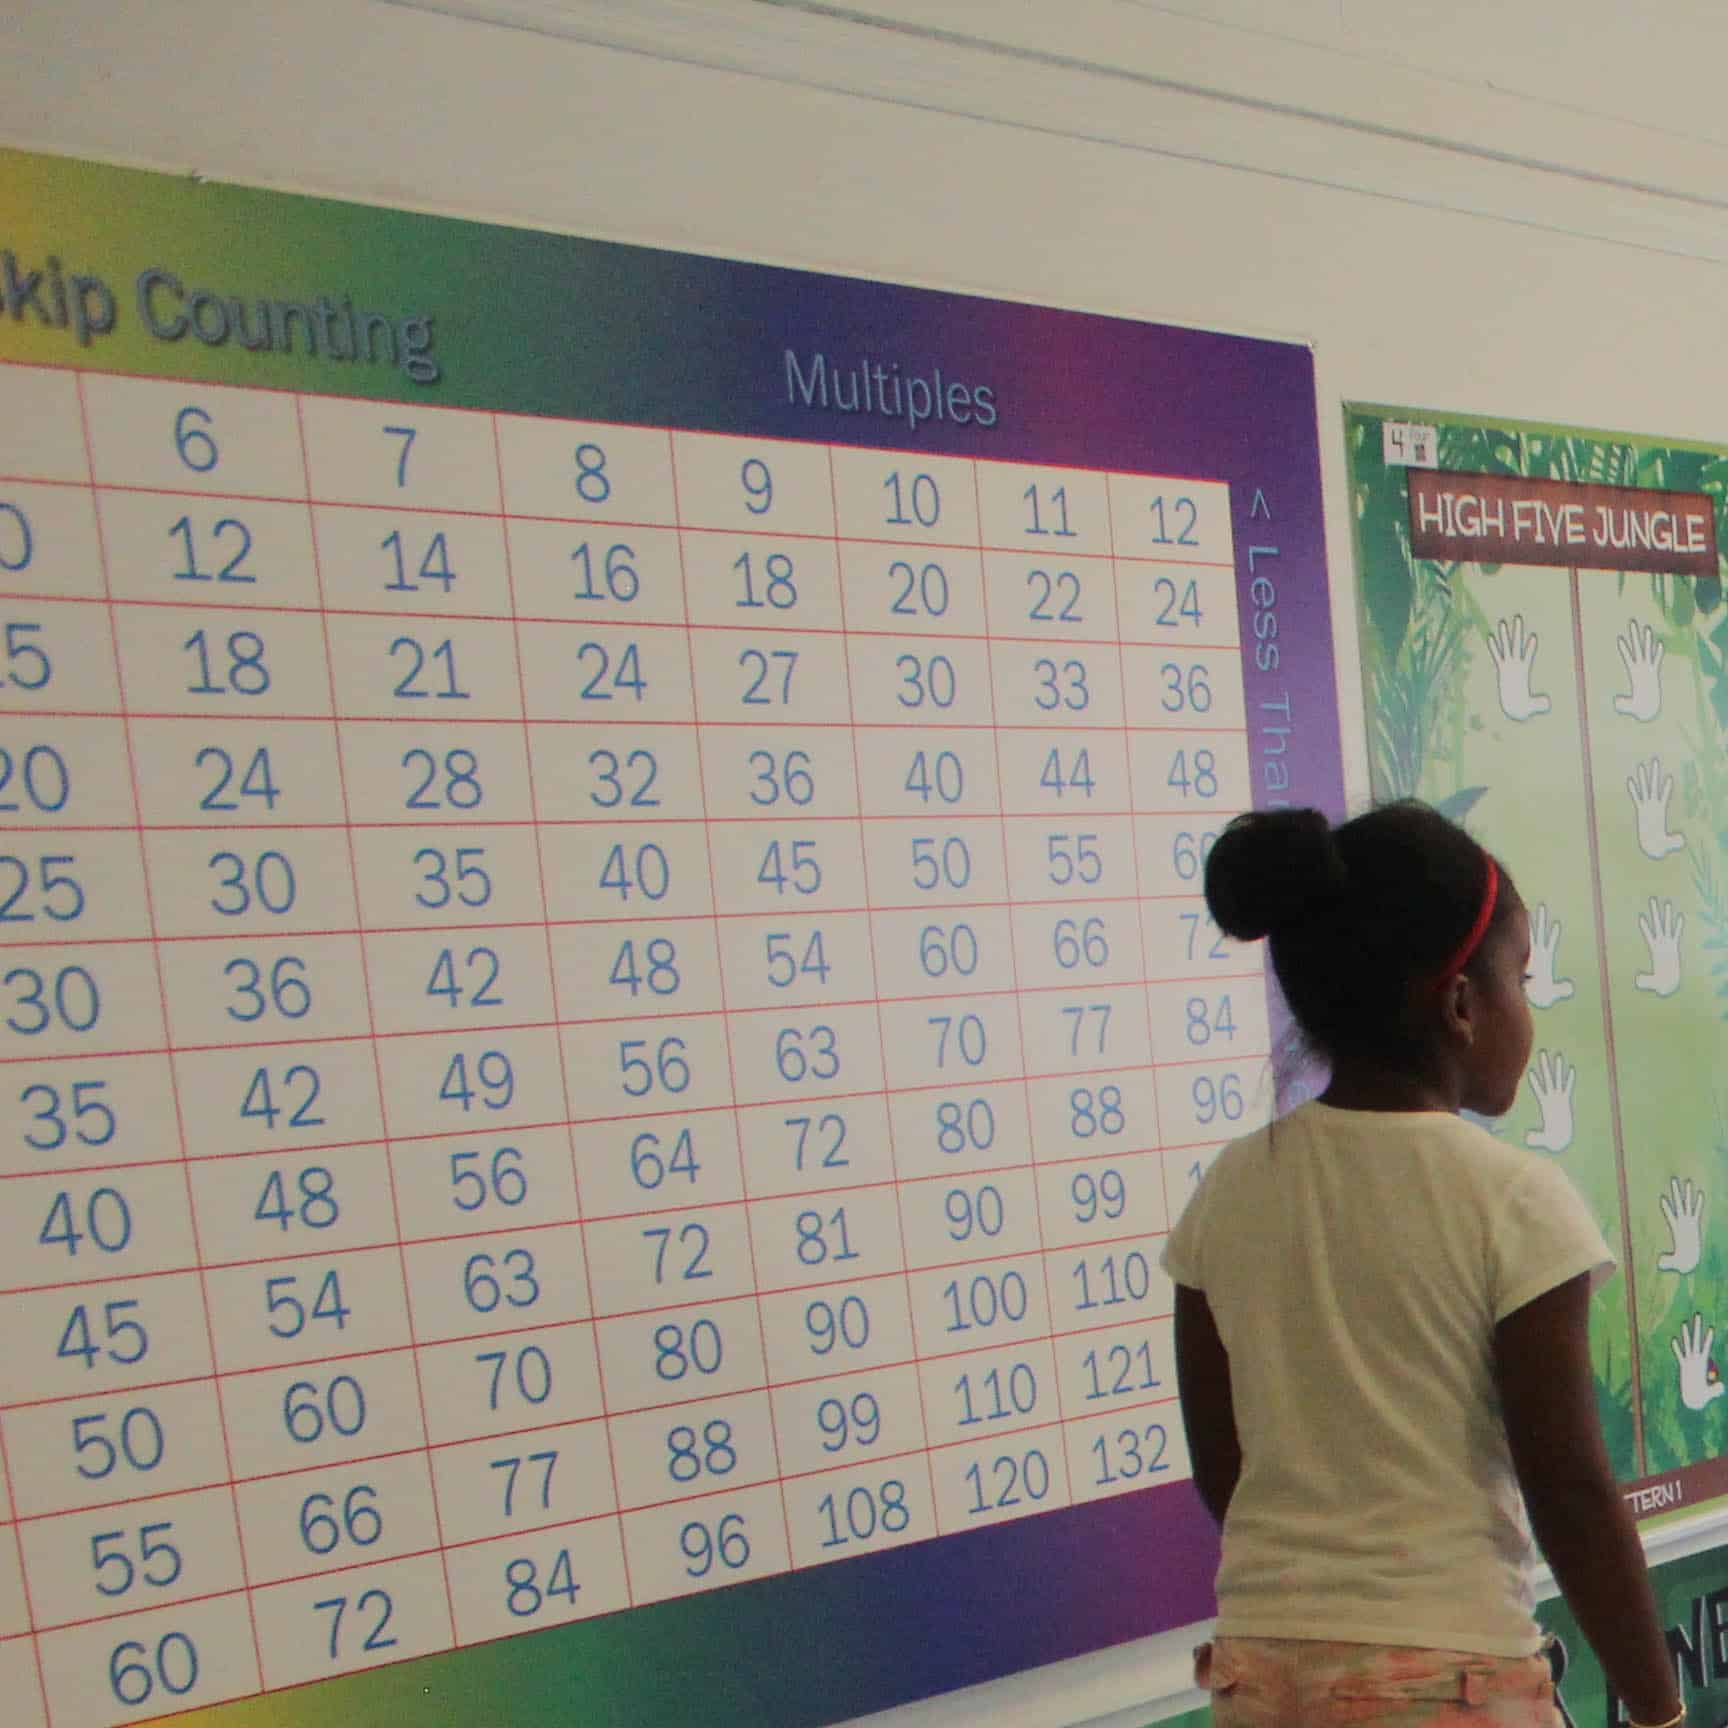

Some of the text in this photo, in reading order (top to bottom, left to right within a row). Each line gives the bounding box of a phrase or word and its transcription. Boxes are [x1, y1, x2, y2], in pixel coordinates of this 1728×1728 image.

[0, 250, 441, 382] kip Counting
[784, 350, 997, 428] Multiples
[175, 404, 1198, 545] 6 7 8 9 10 11 12
[1419, 491, 1707, 554] HIGH FIVE JUNGLE
[169, 515, 1201, 625] 12 14 16 18 20 22 24
[0, 622, 1209, 712] 5 18 21 24 27 30 33 36
[1248, 546, 1291, 808] Less Tha
[194, 746, 1216, 812] 24 28 32 36 40 44 48
[209, 849, 296, 916] 30
[414, 847, 492, 909] 35
[596, 841, 670, 901] 40
[756, 839, 821, 895] 45
[911, 835, 971, 890] 50
[1048, 832, 1102, 886] 55
[3, 965, 103, 1036] 30
[223, 954, 312, 1022] 36
[425, 946, 507, 1008] 42
[608, 937, 681, 995] 48
[764, 928, 831, 989] 54
[918, 922, 978, 976] 60
[1053, 916, 1108, 969] 66
[20, 994, 1237, 1152] 35 42 49 56 63 70 77 84
[36, 1072, 1244, 1258] 40 48 56 64 72 80 88 96
[55, 1168, 1126, 1370] 45 54 63 72 81 90 99
[71, 1249, 1149, 1480] 50 60 70 80 90 100 110
[91, 1343, 1160, 1597] 55 66 77 88 99 110 121
[108, 1424, 1165, 1706] 60 72 84 96 108 120 132
